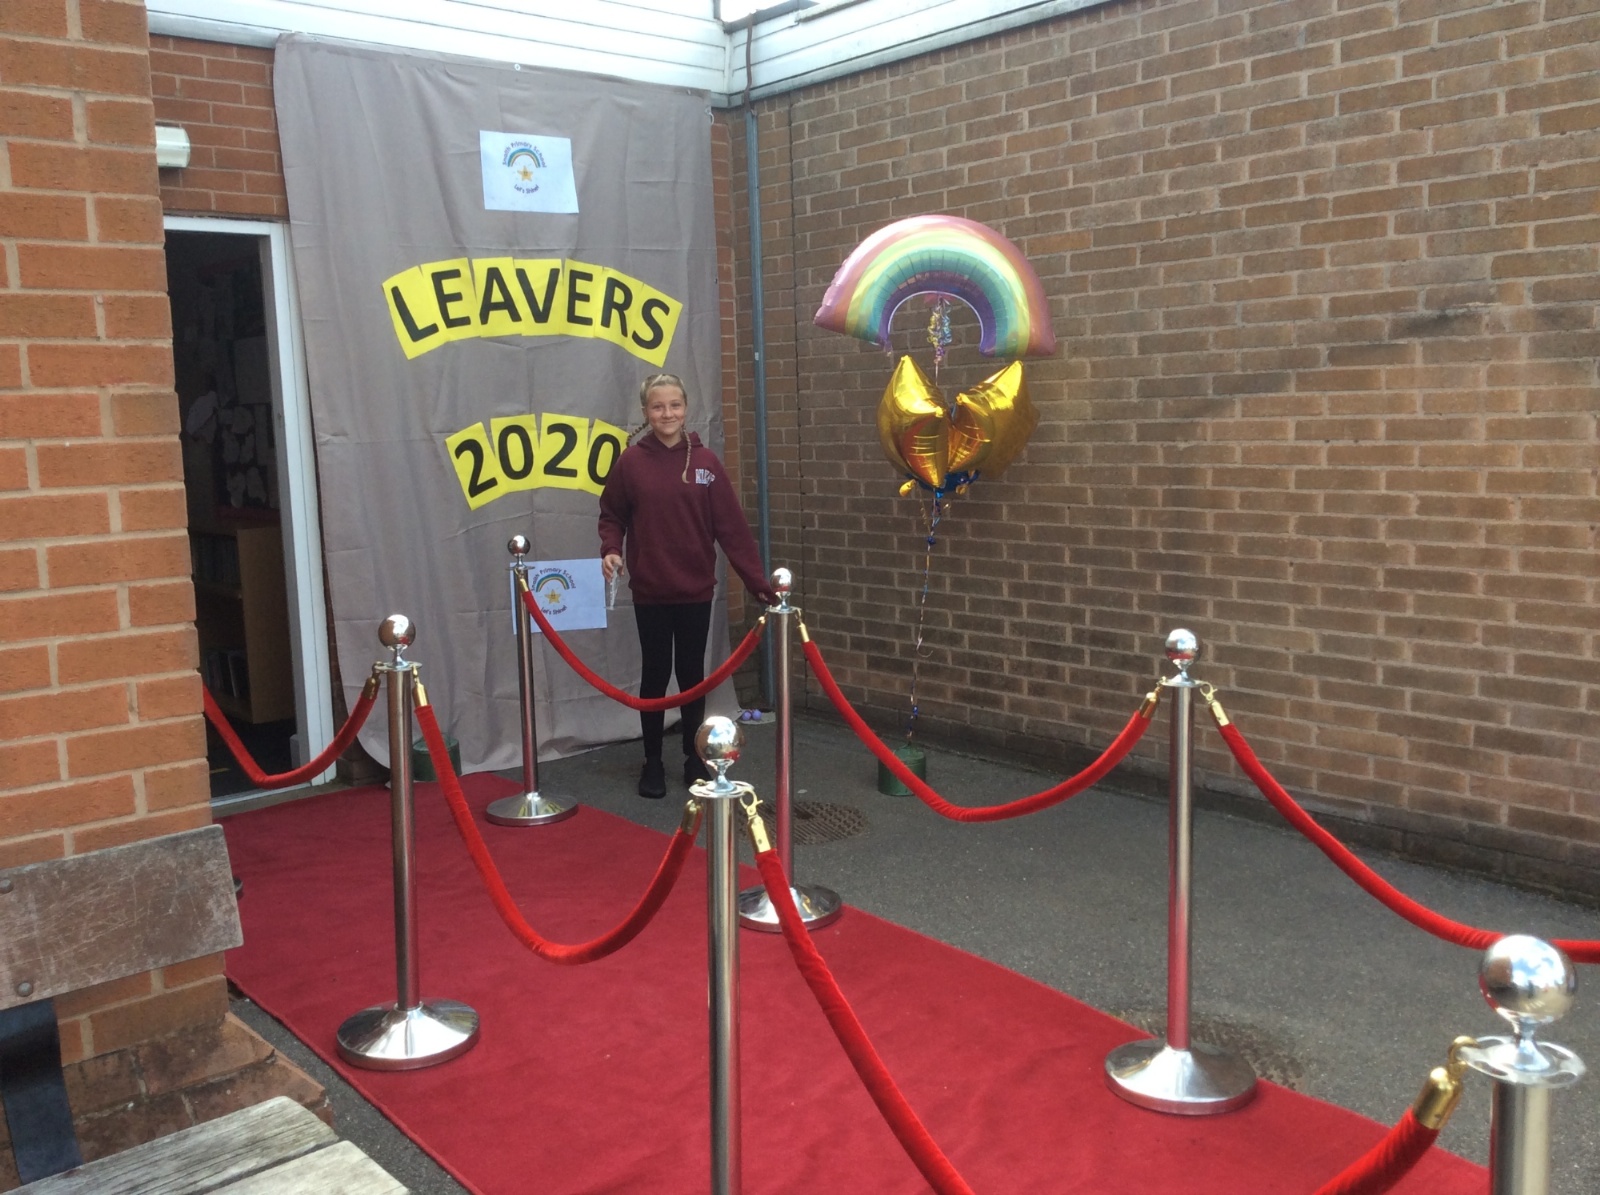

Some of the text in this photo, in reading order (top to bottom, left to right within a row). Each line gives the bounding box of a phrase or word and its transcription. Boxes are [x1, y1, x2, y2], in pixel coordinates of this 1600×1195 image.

[511, 141, 533, 149] Primary
[533, 146, 547, 168] School
[391, 267, 671, 350] LEAVERS
[454, 423, 621, 499] 2020
[539, 567, 562, 575] Primary
[562, 569, 576, 589] School
